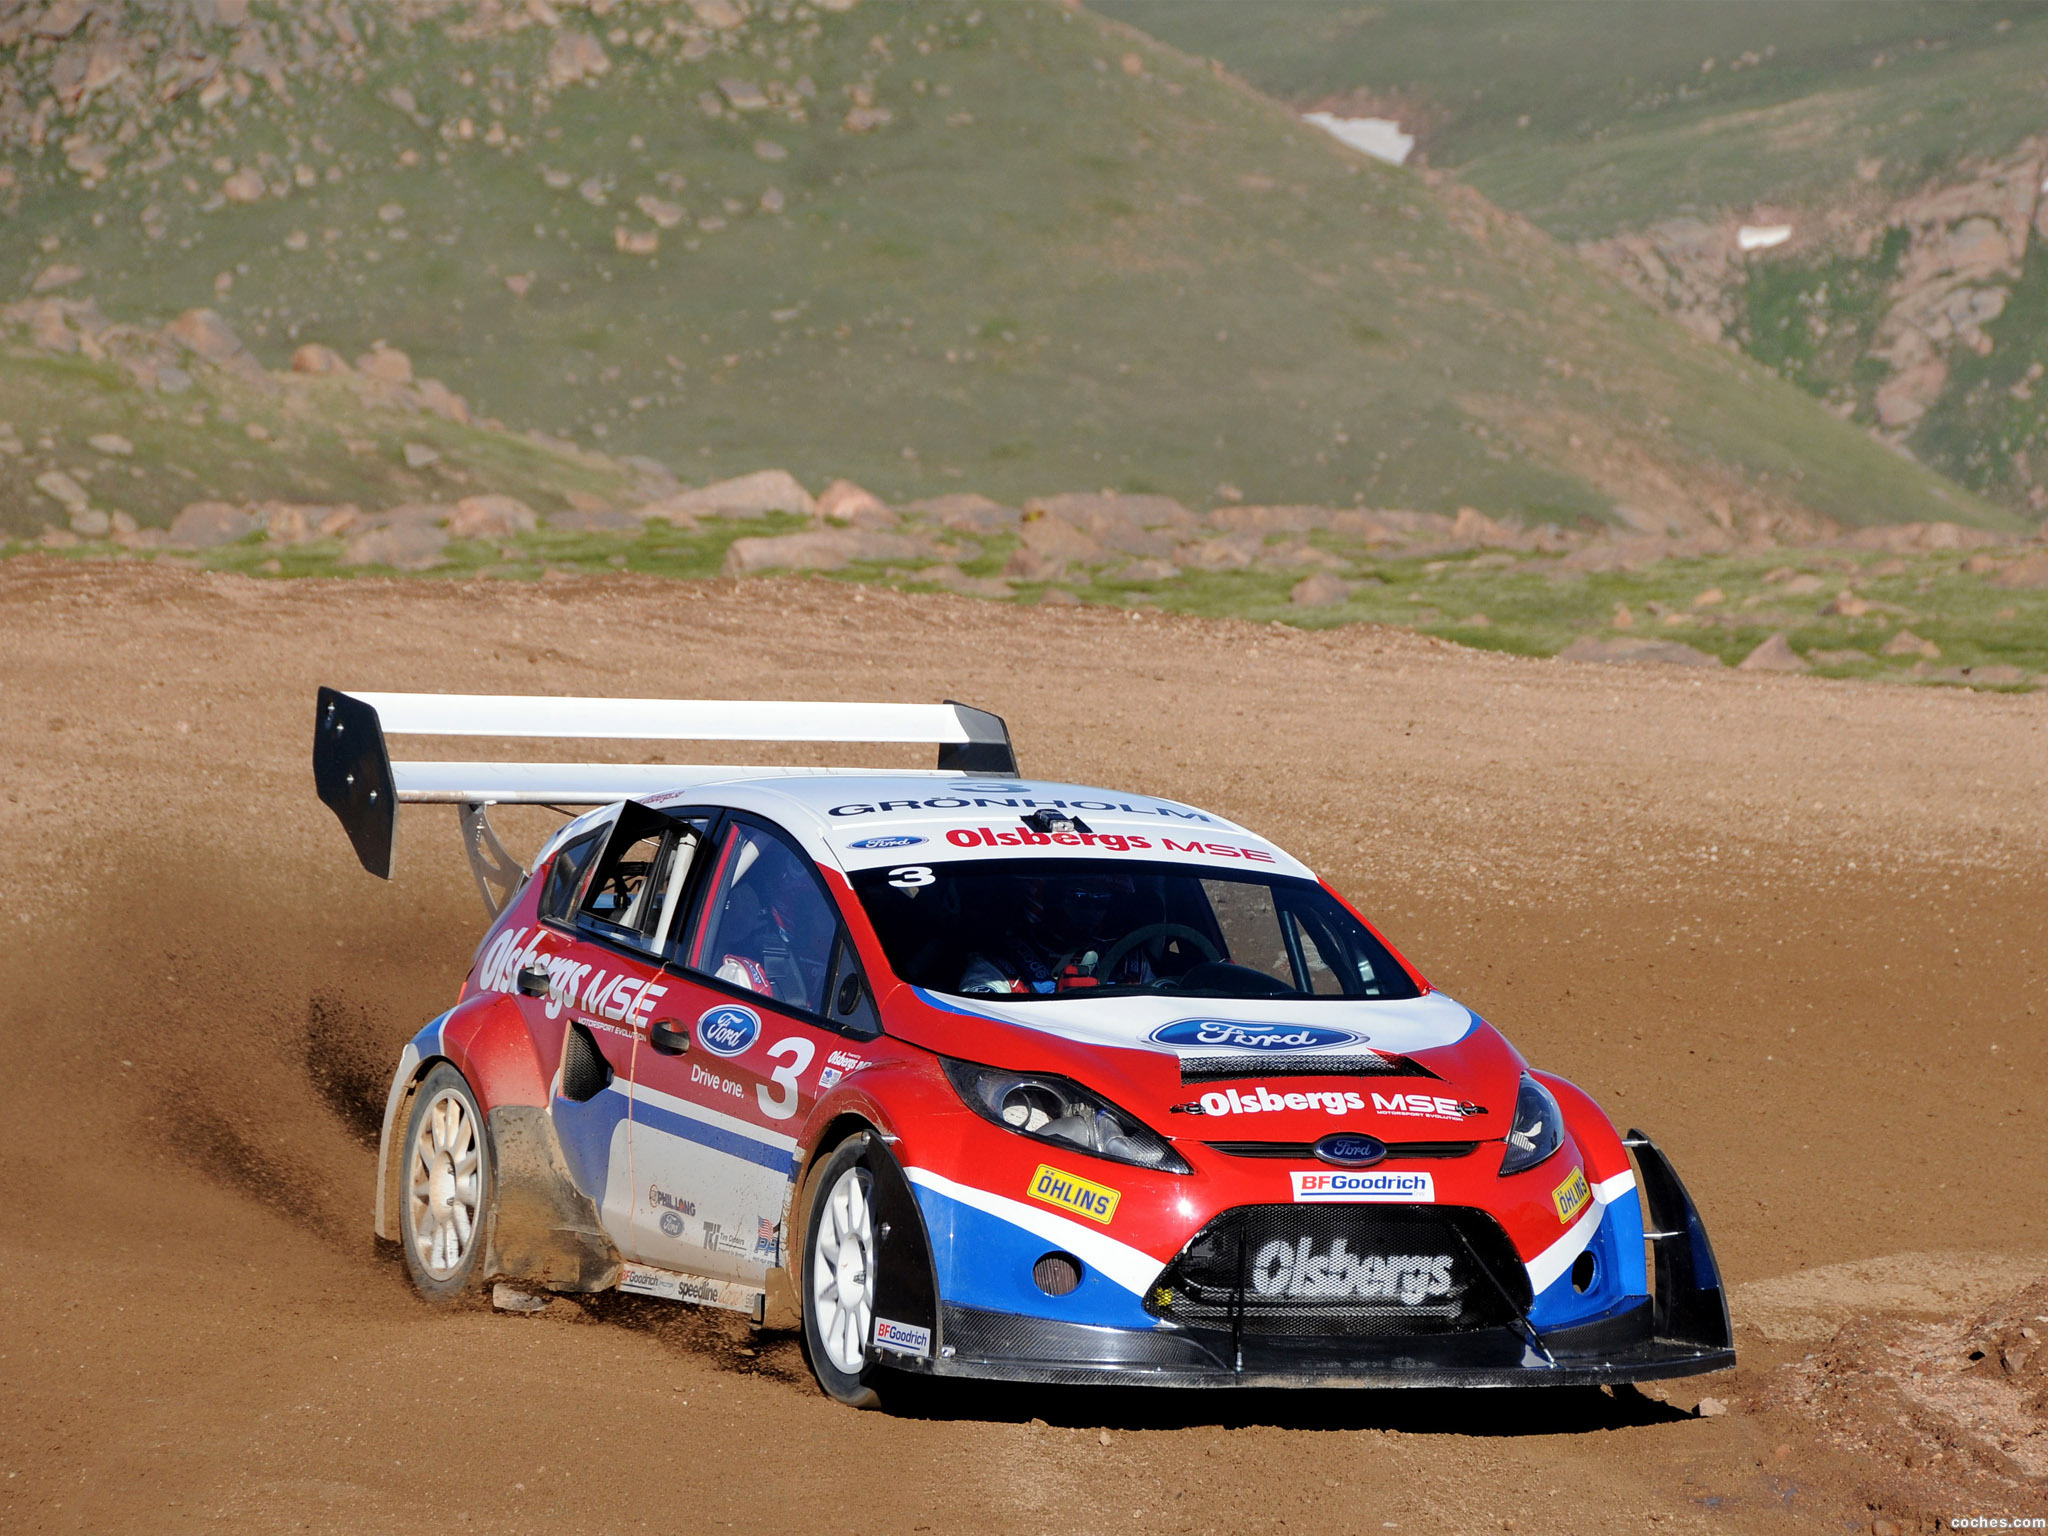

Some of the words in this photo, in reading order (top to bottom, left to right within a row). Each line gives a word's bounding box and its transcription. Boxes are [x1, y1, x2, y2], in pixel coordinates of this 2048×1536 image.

[828, 797, 1211, 823] GRÖNHOLM
[865, 837, 911, 849] Ford
[945, 826, 1152, 852] Olsbergs
[1161, 838, 1277, 864] MSE
[888, 866, 936, 888] 3
[581, 970, 669, 1029] MSE
[706, 1012, 748, 1047] Ford
[1196, 1021, 1318, 1047] Ford
[690, 1063, 720, 1090] Drive
[721, 1078, 745, 1099] one.
[756, 1036, 816, 1120] 3
[1200, 1087, 1364, 1117] Olsbergs
[1371, 1092, 1462, 1117] MSE
[1376, 1110, 1424, 1118] MOTORSPORT
[1334, 1139, 1371, 1157] Ford
[1036, 1169, 1111, 1216] ÖHLINS
[1301, 1175, 1427, 1190] BFGoodrich
[1557, 1175, 1588, 1215] ÖHLINS
[621, 1269, 659, 1287] BFGoodrich
[1252, 1236, 1454, 1306] Olsbergs
[677, 1280, 719, 1303] speedline
[878, 1322, 928, 1347] BFGoodrich
